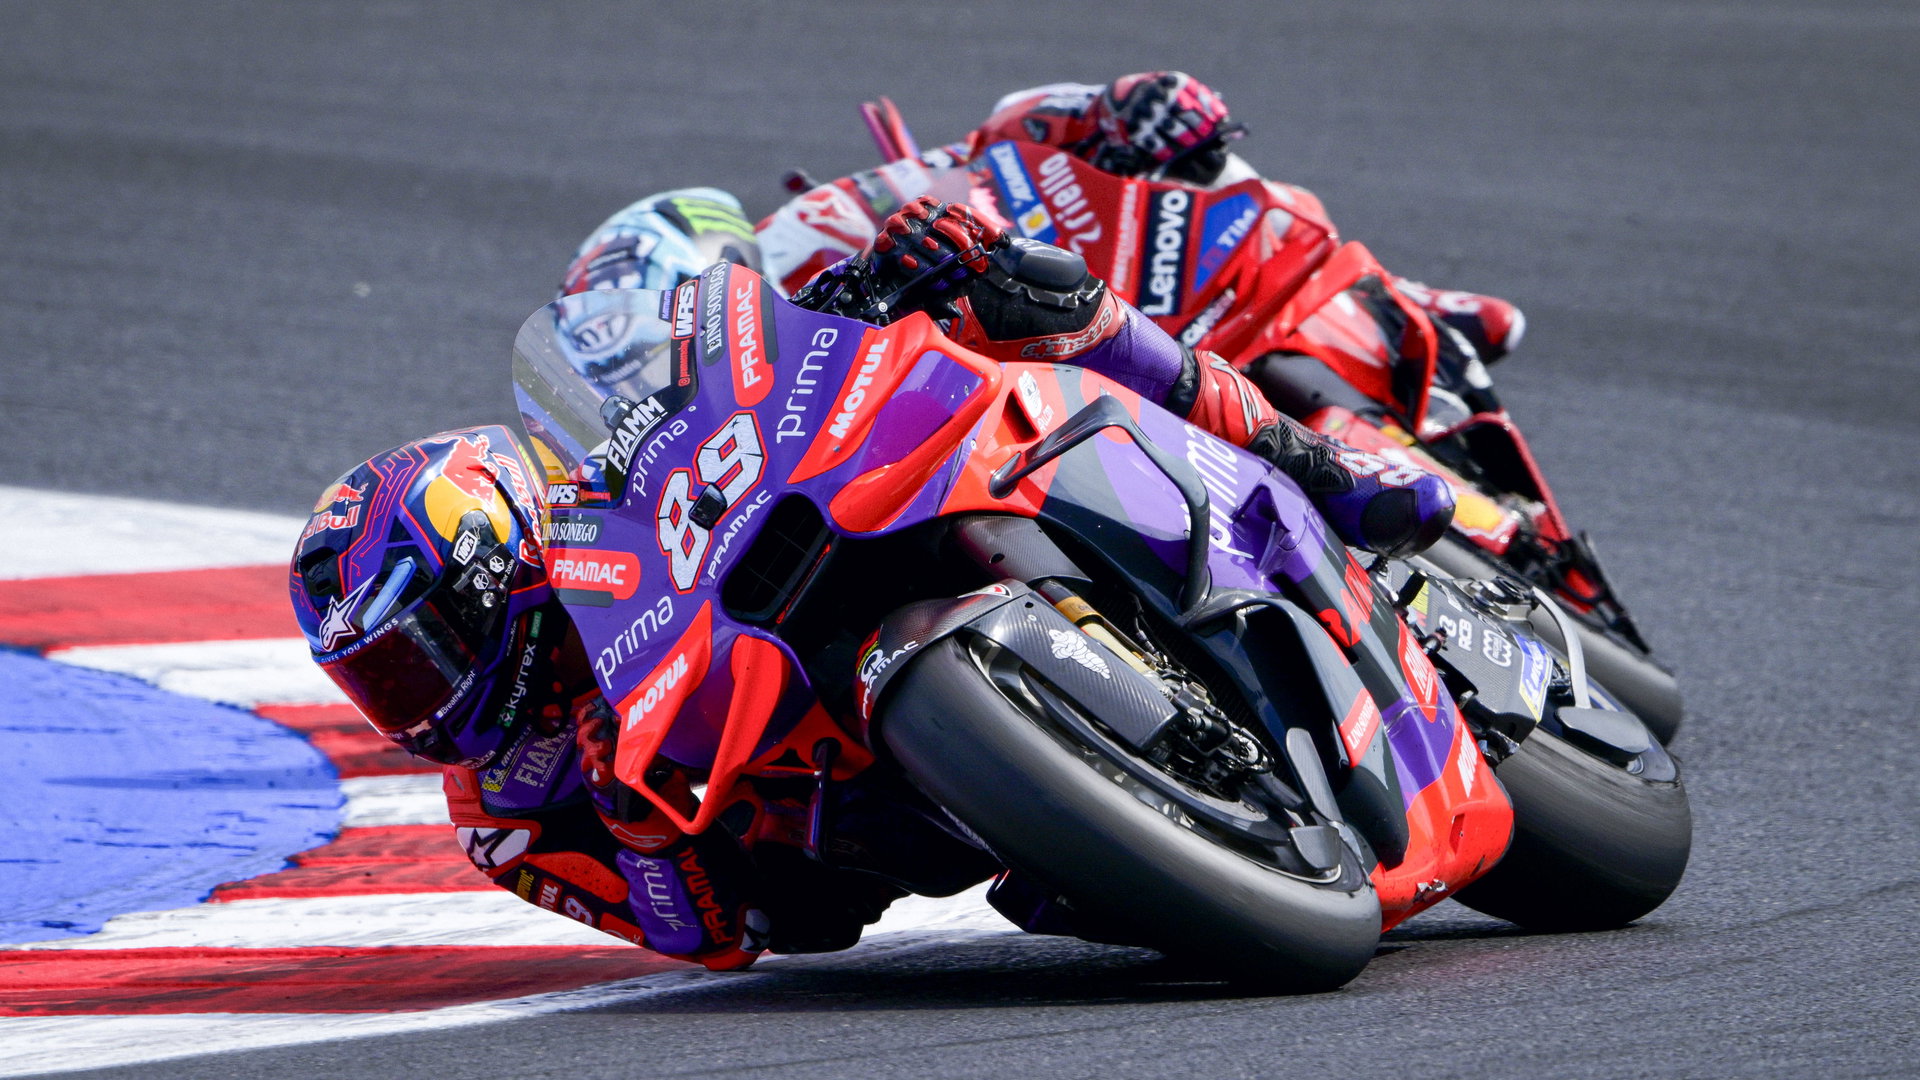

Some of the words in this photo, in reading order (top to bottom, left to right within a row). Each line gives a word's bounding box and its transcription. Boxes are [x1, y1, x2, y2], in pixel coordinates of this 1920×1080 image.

[1141, 189, 1189, 316] Lenovo
[1216, 208, 1258, 248] TIM
[675, 285, 696, 338] WRS
[706, 263, 727, 317] SONEGO
[736, 280, 762, 389] PRAMAC
[776, 327, 838, 444] prima
[828, 338, 889, 440] MOTUL
[606, 395, 666, 473] FIAMM
[633, 419, 689, 497] prima
[545, 483, 579, 504] WRS
[656, 410, 768, 594] 89
[457, 535, 476, 560] 100%
[558, 523, 598, 542] SONEGO
[707, 490, 772, 579] PRAMAC
[552, 559, 627, 585] PRAMAC
[342, 643, 361, 657] YOU
[363, 617, 399, 644] WINGS
[595, 595, 674, 690] prima
[1458, 618, 1473, 652] RCB
[440, 689, 463, 716] Breathe
[460, 669, 476, 692] Right
[505, 643, 537, 710] kyrrex
[627, 653, 689, 732] MOTUL
[540, 884, 559, 911] TUL
[636, 858, 697, 931] prima
